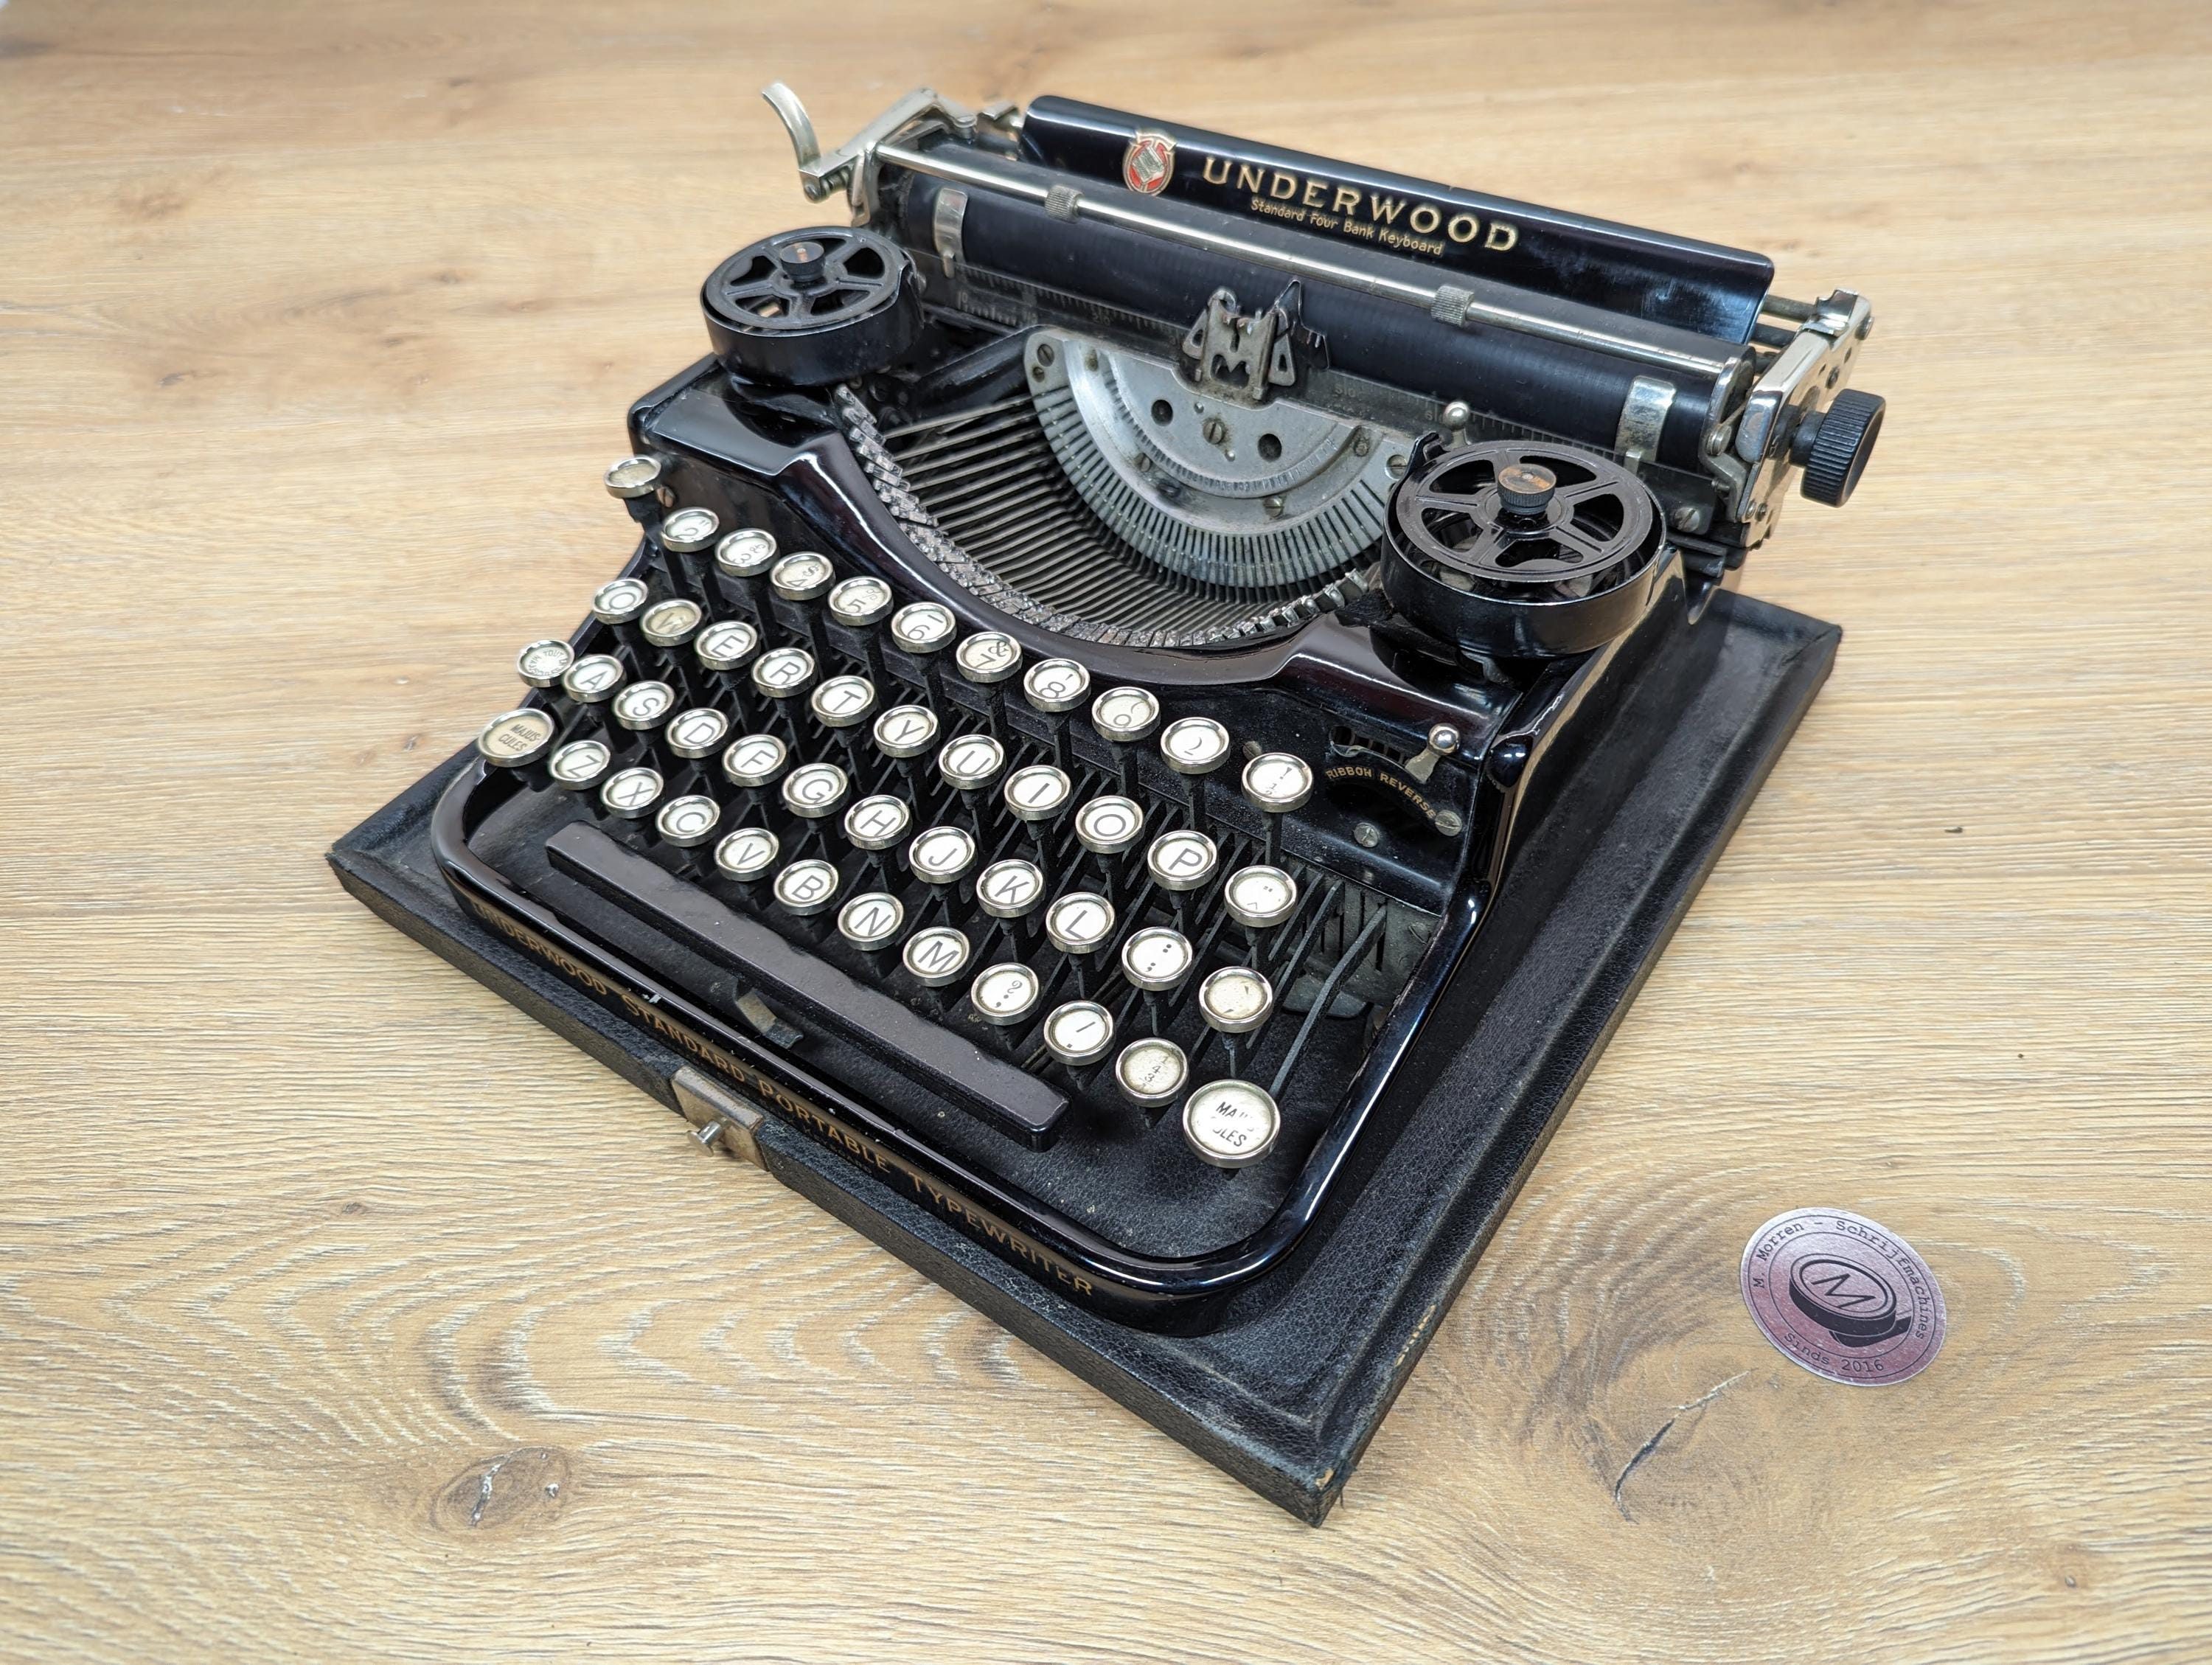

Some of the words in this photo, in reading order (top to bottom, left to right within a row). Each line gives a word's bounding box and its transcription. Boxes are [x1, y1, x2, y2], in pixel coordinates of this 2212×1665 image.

[1202, 156, 1518, 251] UNDERWOOD
[1251, 199, 1306, 223] Standard
[1310, 213, 1338, 231] Four
[1343, 218, 1375, 240] Bank
[1378, 229, 1444, 257] Keyboard
[843, 598, 866, 613] 5
[908, 625, 931, 640] 6
[711, 635, 745, 658] E
[988, 642, 1009, 658] &
[975, 653, 997, 669] 7
[580, 670, 609, 690] A
[769, 661, 801, 685] R
[832, 690, 862, 712] T
[1040, 681, 1066, 698] 8
[632, 698, 661, 717] S
[684, 723, 716, 745] D
[894, 720, 925, 742] Y
[568, 754, 601, 776] Z
[740, 749, 776, 768] F
[956, 751, 991, 774] U
[618, 782, 654, 807] X
[802, 779, 833, 803] G
[1028, 783, 1050, 804] I
[1325, 765, 1372, 779] RIBBON
[1380, 773, 1436, 819] REVERSE
[676, 812, 706, 832] C
[860, 810, 897, 837] H
[1093, 813, 1127, 836] O
[737, 843, 766, 865] V
[928, 848, 958, 866] J
[1168, 848, 1203, 870] P
[792, 875, 824, 900] B
[994, 875, 1030, 903] K
[854, 906, 891, 936] N
[1065, 910, 1088, 939] L
[918, 941, 960, 972] M
[472, 901, 608, 995] UNDERWOOD
[619, 993, 745, 1082] STANDARD
[759, 1080, 891, 1174] PORTABLE
[908, 1172, 1092, 1296] TYPEWRITER
[1756, 1221, 1804, 1262] Morren
[1836, 1220, 1931, 1341] Schrijfmachines
[1784, 1332, 1830, 1366] Sinds
[1841, 1359, 1885, 1373] 2016
